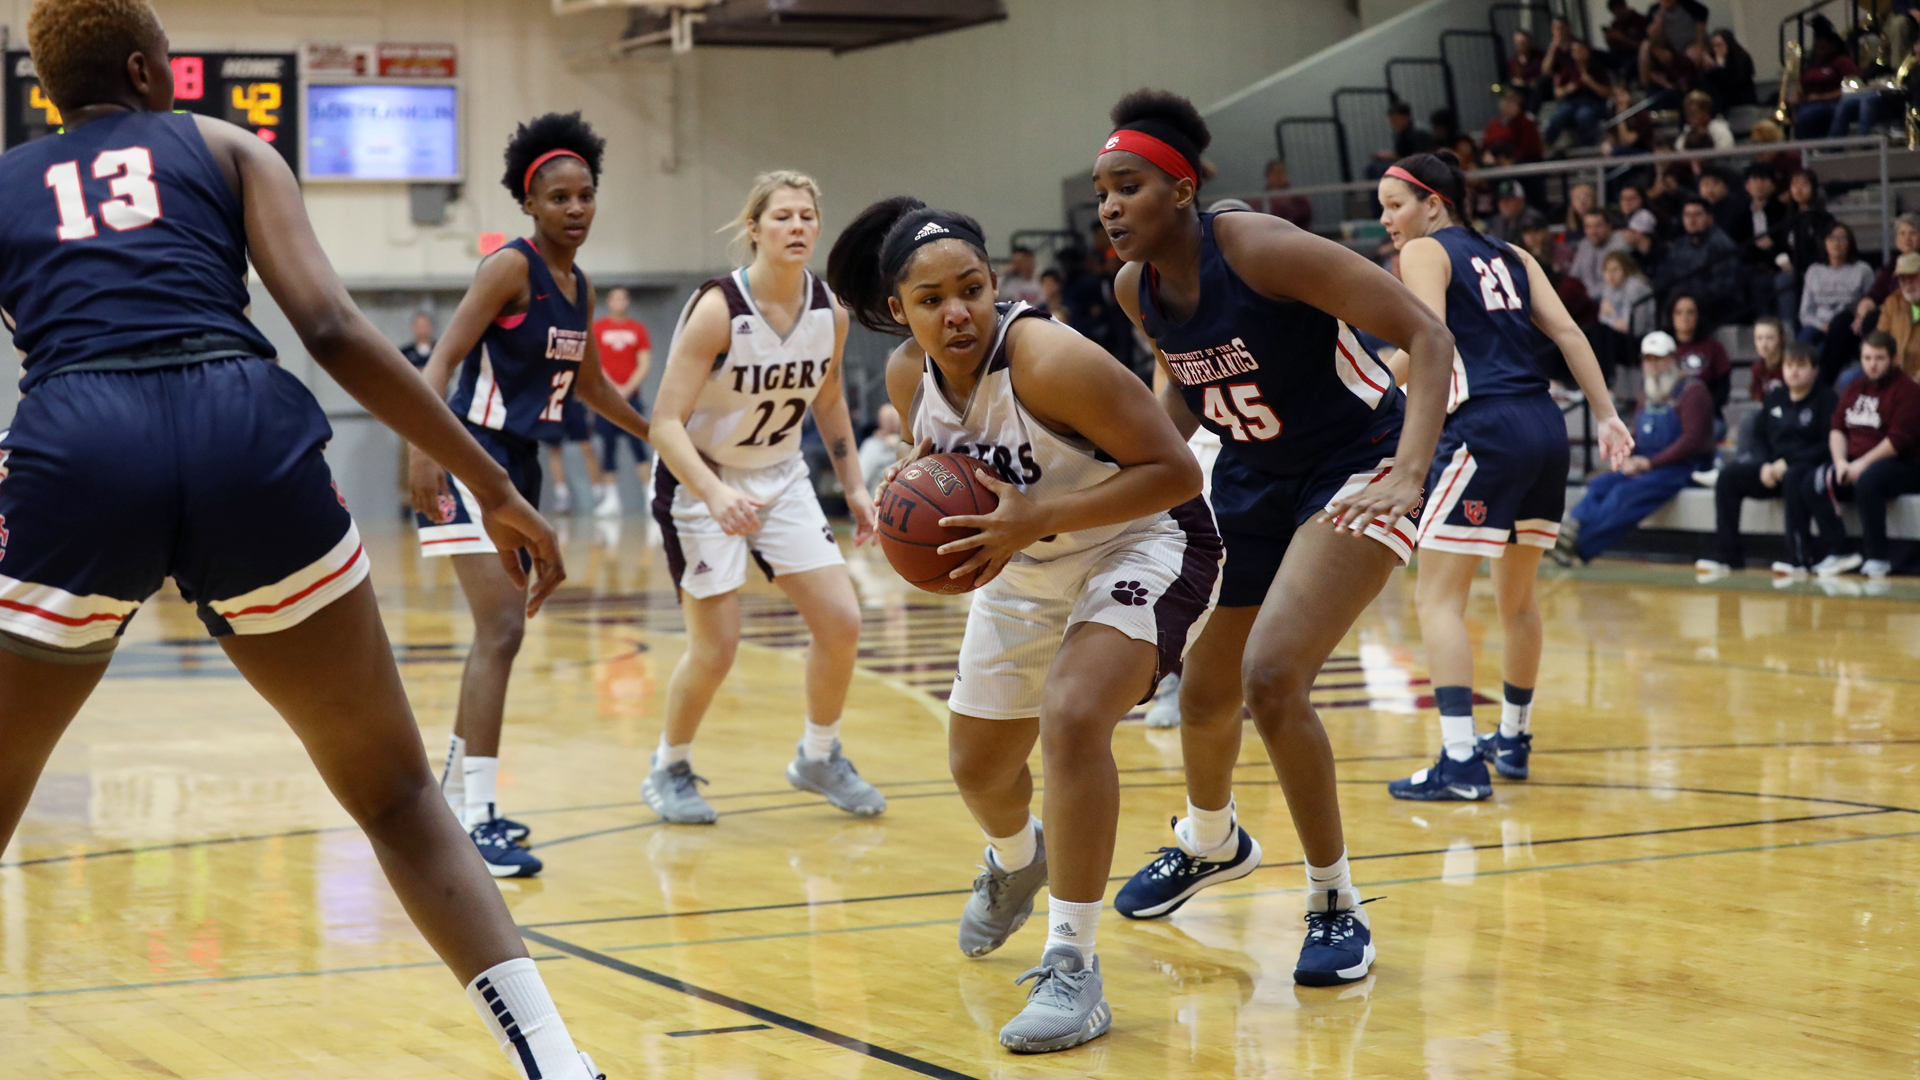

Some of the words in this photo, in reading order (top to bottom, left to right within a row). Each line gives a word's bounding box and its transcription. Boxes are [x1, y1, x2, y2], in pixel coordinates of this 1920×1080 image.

[221, 58, 284, 78] HOME
[30, 84, 64, 125] 4
[231, 82, 282, 125] 42
[44, 146, 162, 243] 13
[914, 227, 950, 241] adidas
[1470, 256, 1523, 311] 21
[1160, 336, 1260, 386] UMBERLANDS
[1204, 348, 1215, 356] OF
[1215, 344, 1234, 354] THE
[538, 369, 575, 422] 2
[731, 357, 832, 395] TIGERS
[735, 398, 807, 447] 22
[1202, 382, 1283, 442] 45
[911, 456, 965, 497] SPAL
[928, 441, 1042, 485] ERS
